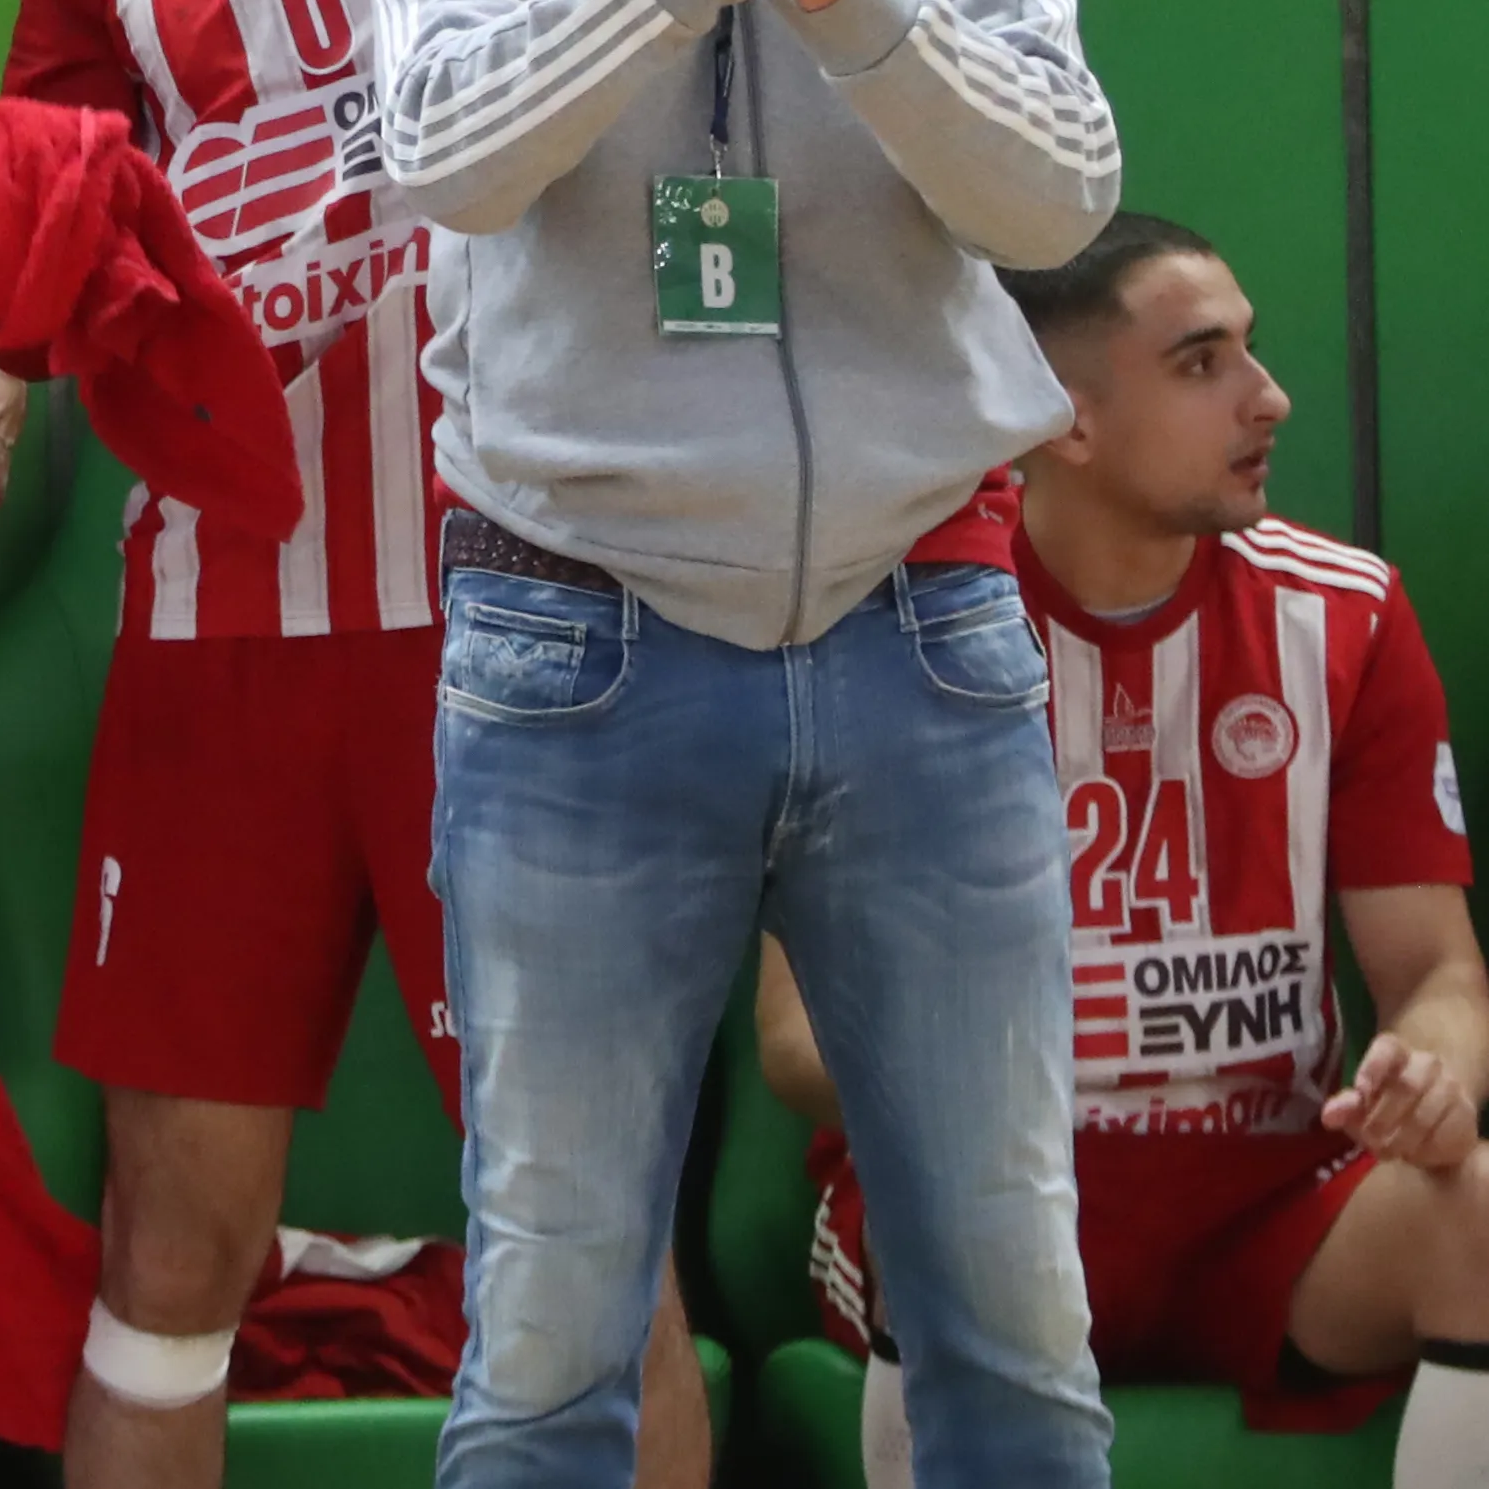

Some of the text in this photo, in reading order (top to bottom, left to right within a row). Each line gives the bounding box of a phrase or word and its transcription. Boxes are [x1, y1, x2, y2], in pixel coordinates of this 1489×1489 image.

[700, 243, 736, 309] B
[1066, 775, 1200, 936] 24
[1134, 941, 1310, 997] ΟΜΙΛΟΣ
[1140, 981, 1303, 1057] ΞΥΝΗ
